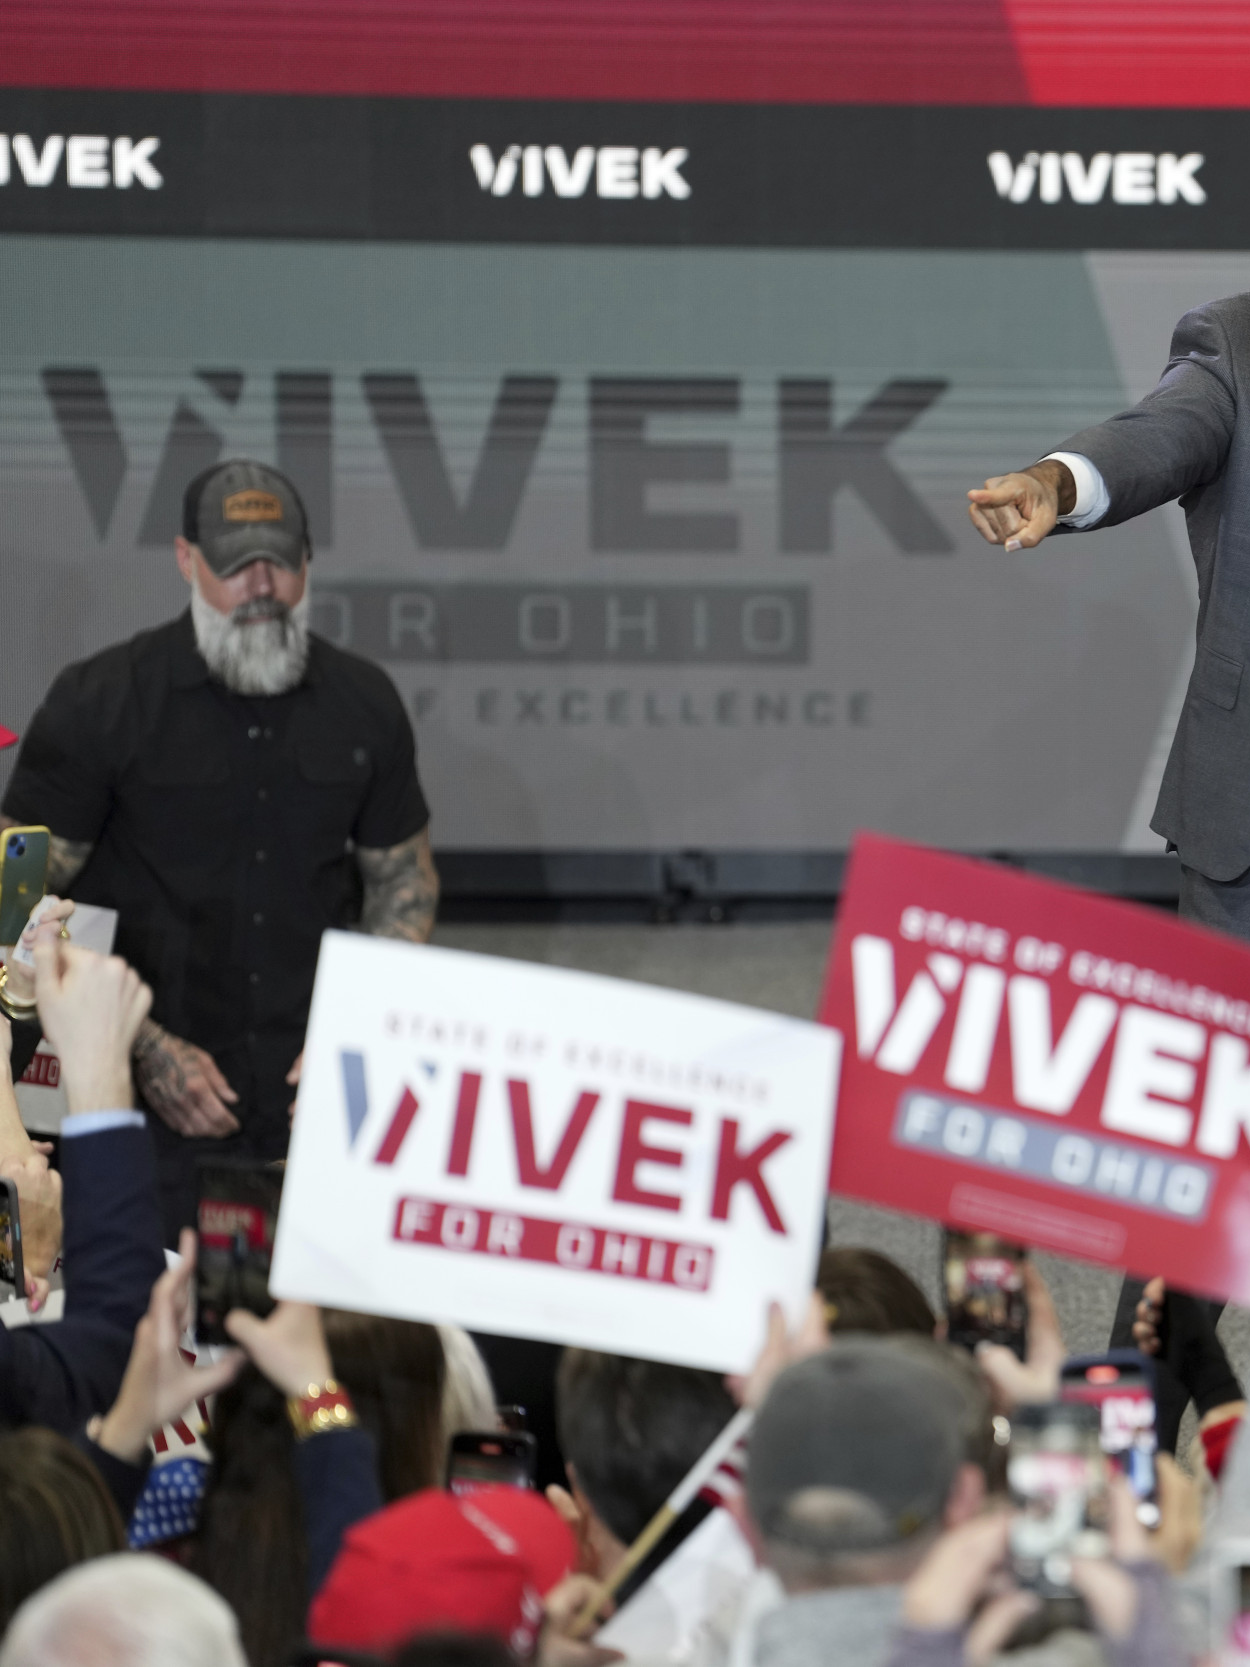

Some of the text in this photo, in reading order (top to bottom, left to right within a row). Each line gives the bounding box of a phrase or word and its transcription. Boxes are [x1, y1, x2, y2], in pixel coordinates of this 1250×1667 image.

[469, 143, 692, 200] VIVEK
[987, 150, 1207, 206] VIVEK
[40, 366, 956, 555] VIVEK
[303, 592, 796, 653] OR OHIO
[477, 688, 875, 728] EXCELLENCE
[900, 904, 1009, 962] STATE
[1014, 935, 1065, 977] OF
[339, 1048, 795, 1237] VIVEK
[902, 1095, 1210, 1217] FOR OHIO
[398, 1199, 712, 1291] FOR OHIO
